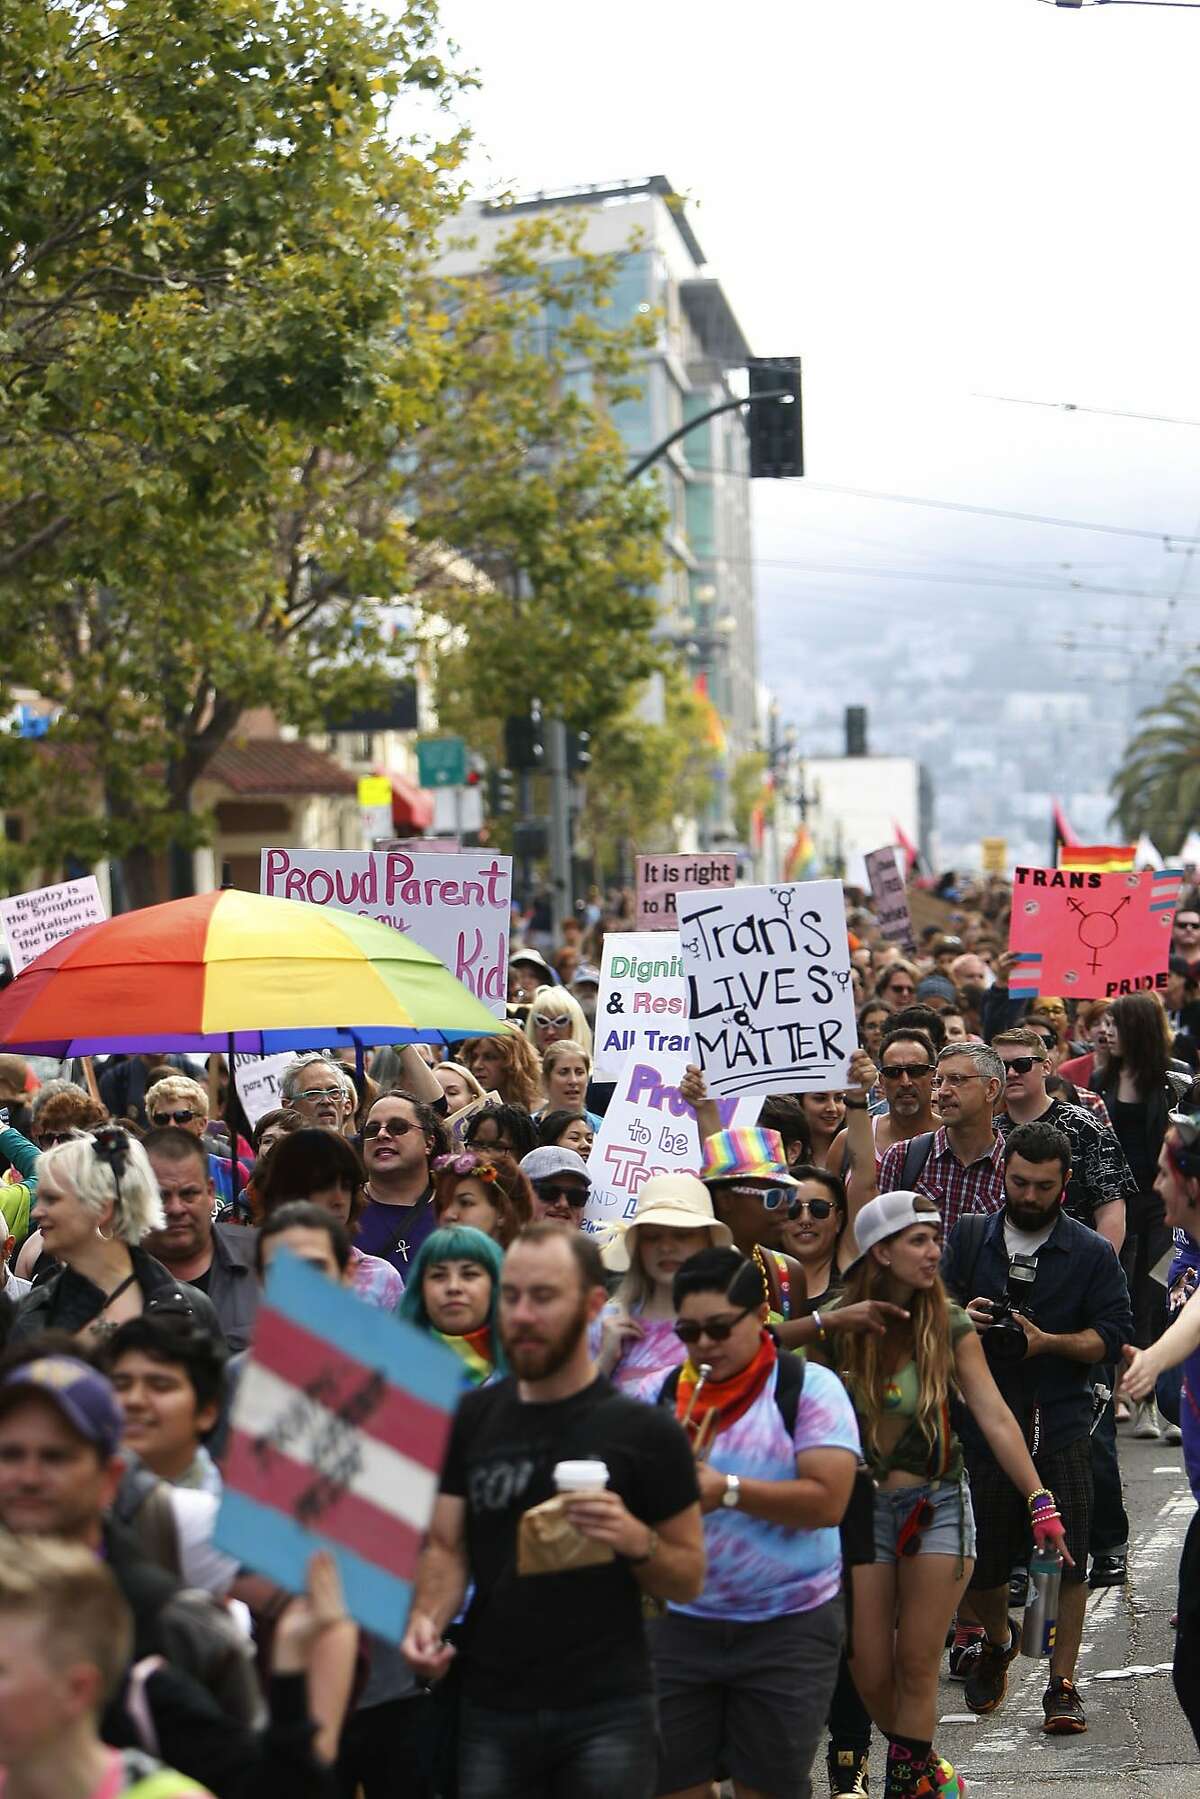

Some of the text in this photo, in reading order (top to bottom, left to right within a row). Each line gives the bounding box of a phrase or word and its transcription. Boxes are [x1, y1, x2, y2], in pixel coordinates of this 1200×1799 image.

[385, 852, 508, 909] Parent
[643, 861, 731, 886] It is right
[1015, 867, 1102, 889] TRANS
[6, 894, 94, 925] the Symptom
[16, 886, 79, 910] Bigotry is
[643, 899, 658, 914] to
[12, 909, 98, 940] Capitalism is
[19, 922, 96, 950] the Dise
[455, 928, 506, 1001] Kid
[610, 955, 685, 984] Dignit
[687, 964, 834, 1020] LIVES
[1105, 972, 1169, 998] PRIDE
[606, 991, 688, 1019] & Res
[603, 1030, 636, 1052] All
[694, 1019, 846, 1072] MATTER
[628, 1118, 689, 1156] to be
[587, 1189, 618, 1207] ND
[1031, 1425, 1040, 1456] DIGITAL
